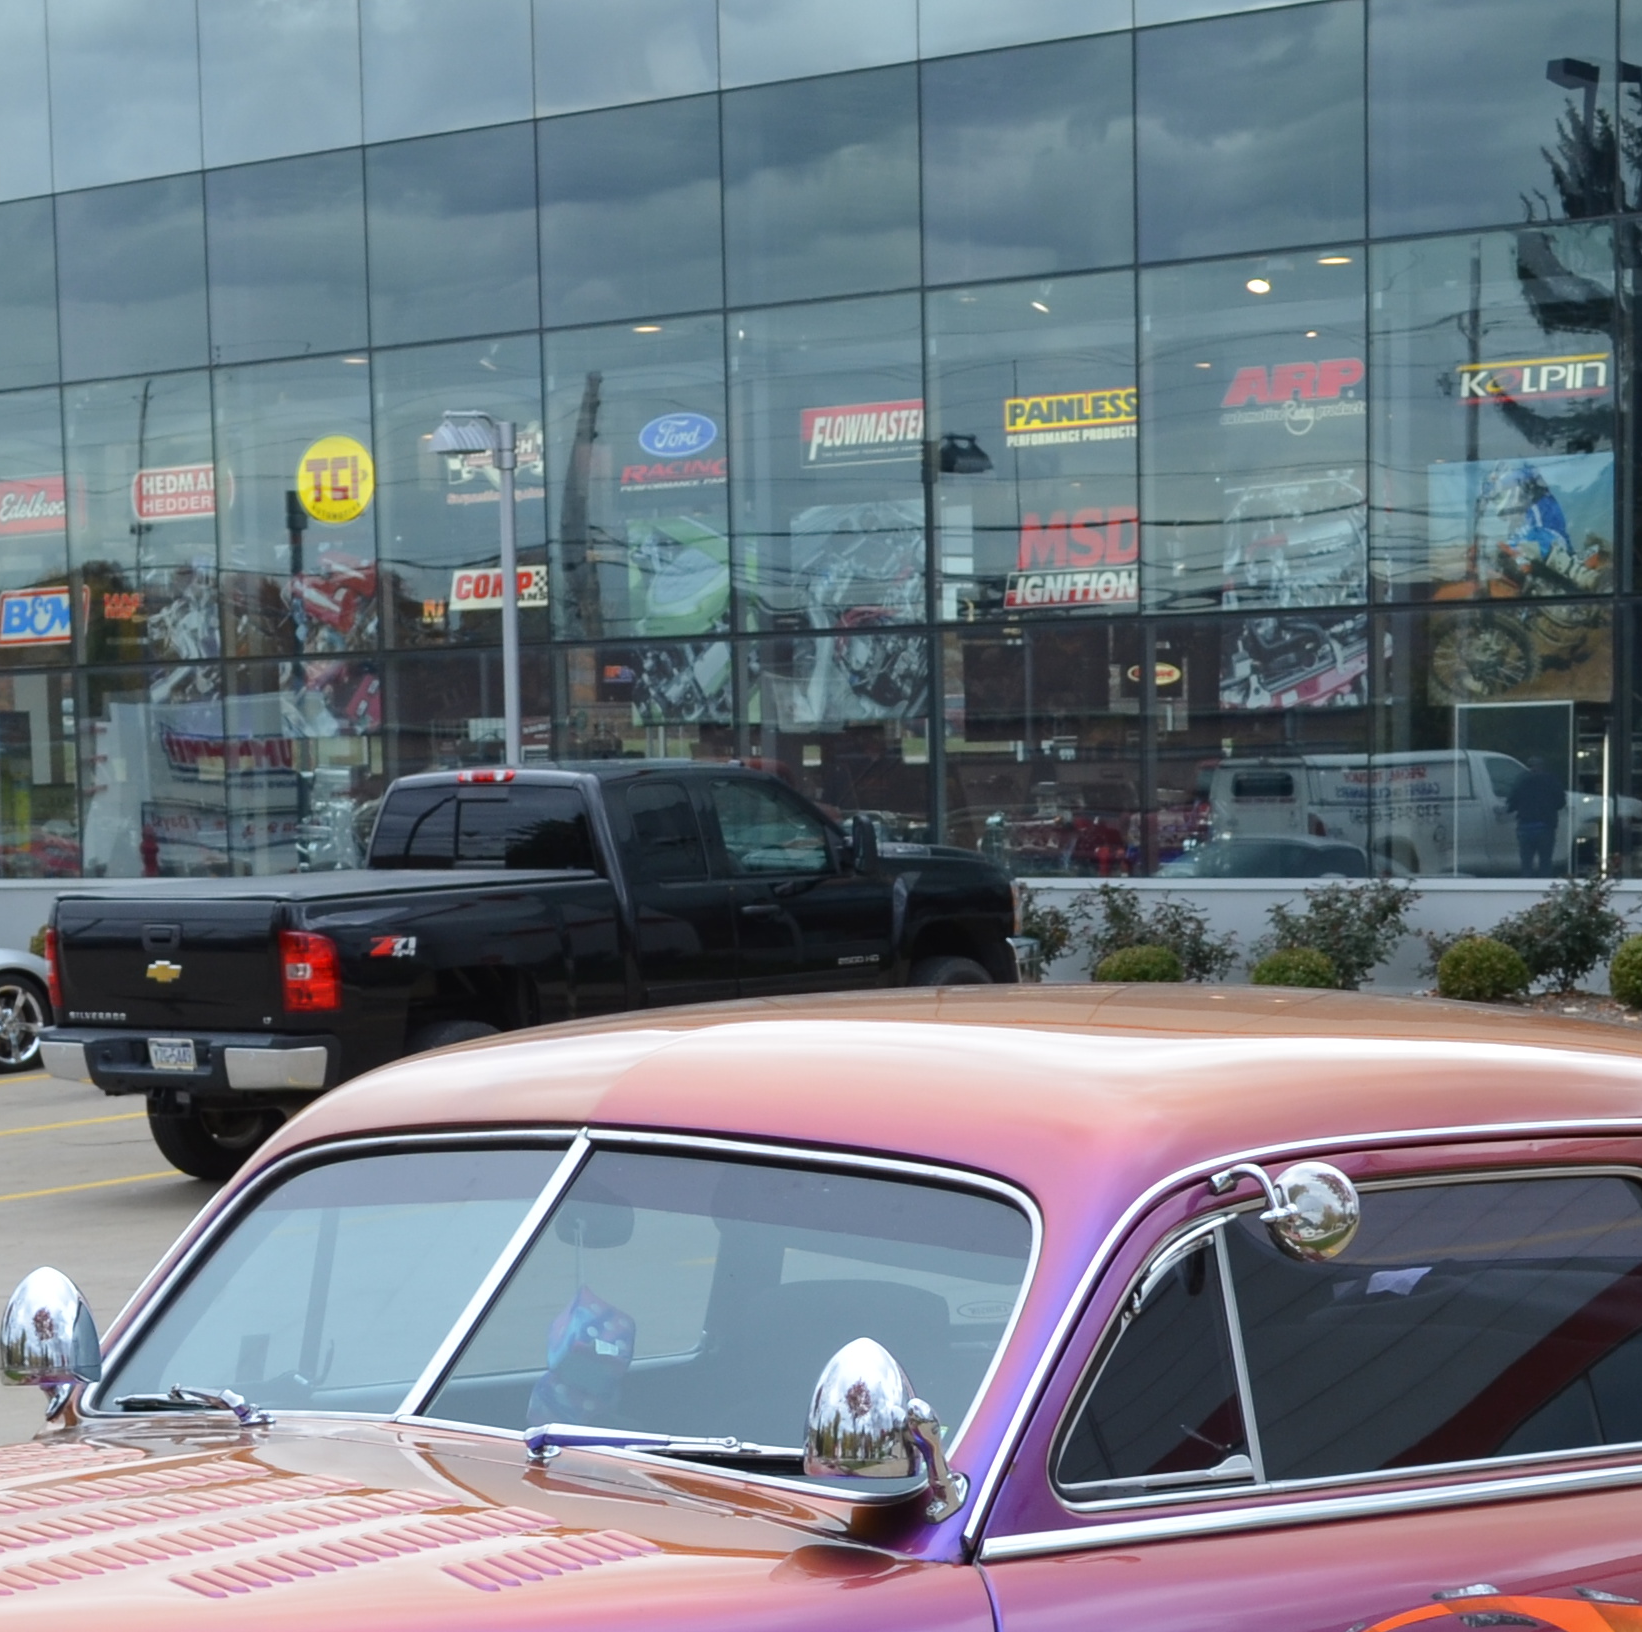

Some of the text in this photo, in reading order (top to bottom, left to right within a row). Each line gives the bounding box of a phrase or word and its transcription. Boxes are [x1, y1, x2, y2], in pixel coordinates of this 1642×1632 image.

[1221, 357, 1365, 408] ARP
[1007, 390, 1137, 428] PAINLESS
[654, 418, 698, 449] Ford
[1007, 425, 1137, 448] PERFORMANCE PRODUCTS
[306, 455, 359, 503] TCI
[620, 480, 700, 492] PERFORMANCE
[0, 491, 66, 522] Edelbroc
[143, 496, 213, 514] HEDDER
[1017, 506, 1139, 570] MSD
[1014, 570, 1139, 605] IGNITION
[370, 934, 417, 957] Z71
